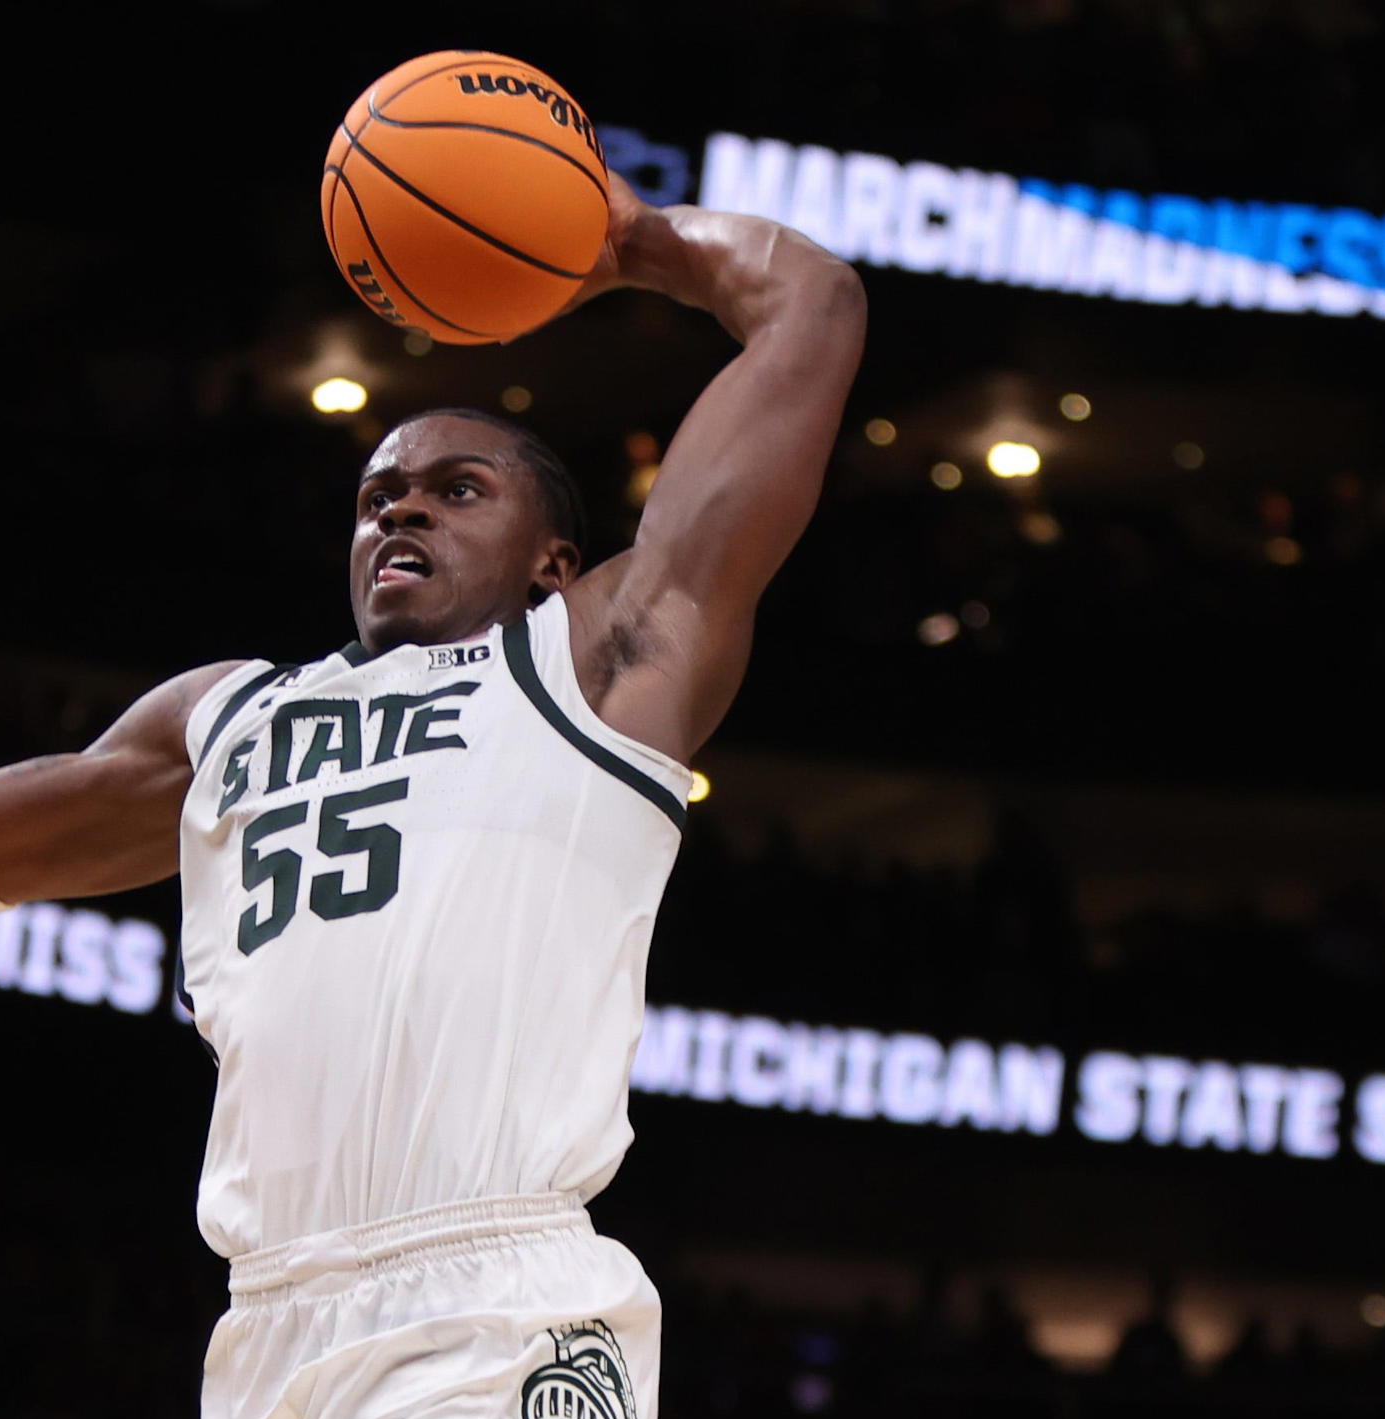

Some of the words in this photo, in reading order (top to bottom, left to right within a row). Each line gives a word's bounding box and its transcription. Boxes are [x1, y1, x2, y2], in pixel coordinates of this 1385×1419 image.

[217, 681, 482, 819] STATE
[236, 777, 410, 957] 55
[627, 1003, 1067, 1136] MICHIGAN
[1073, 1050, 1347, 1160] STATE
